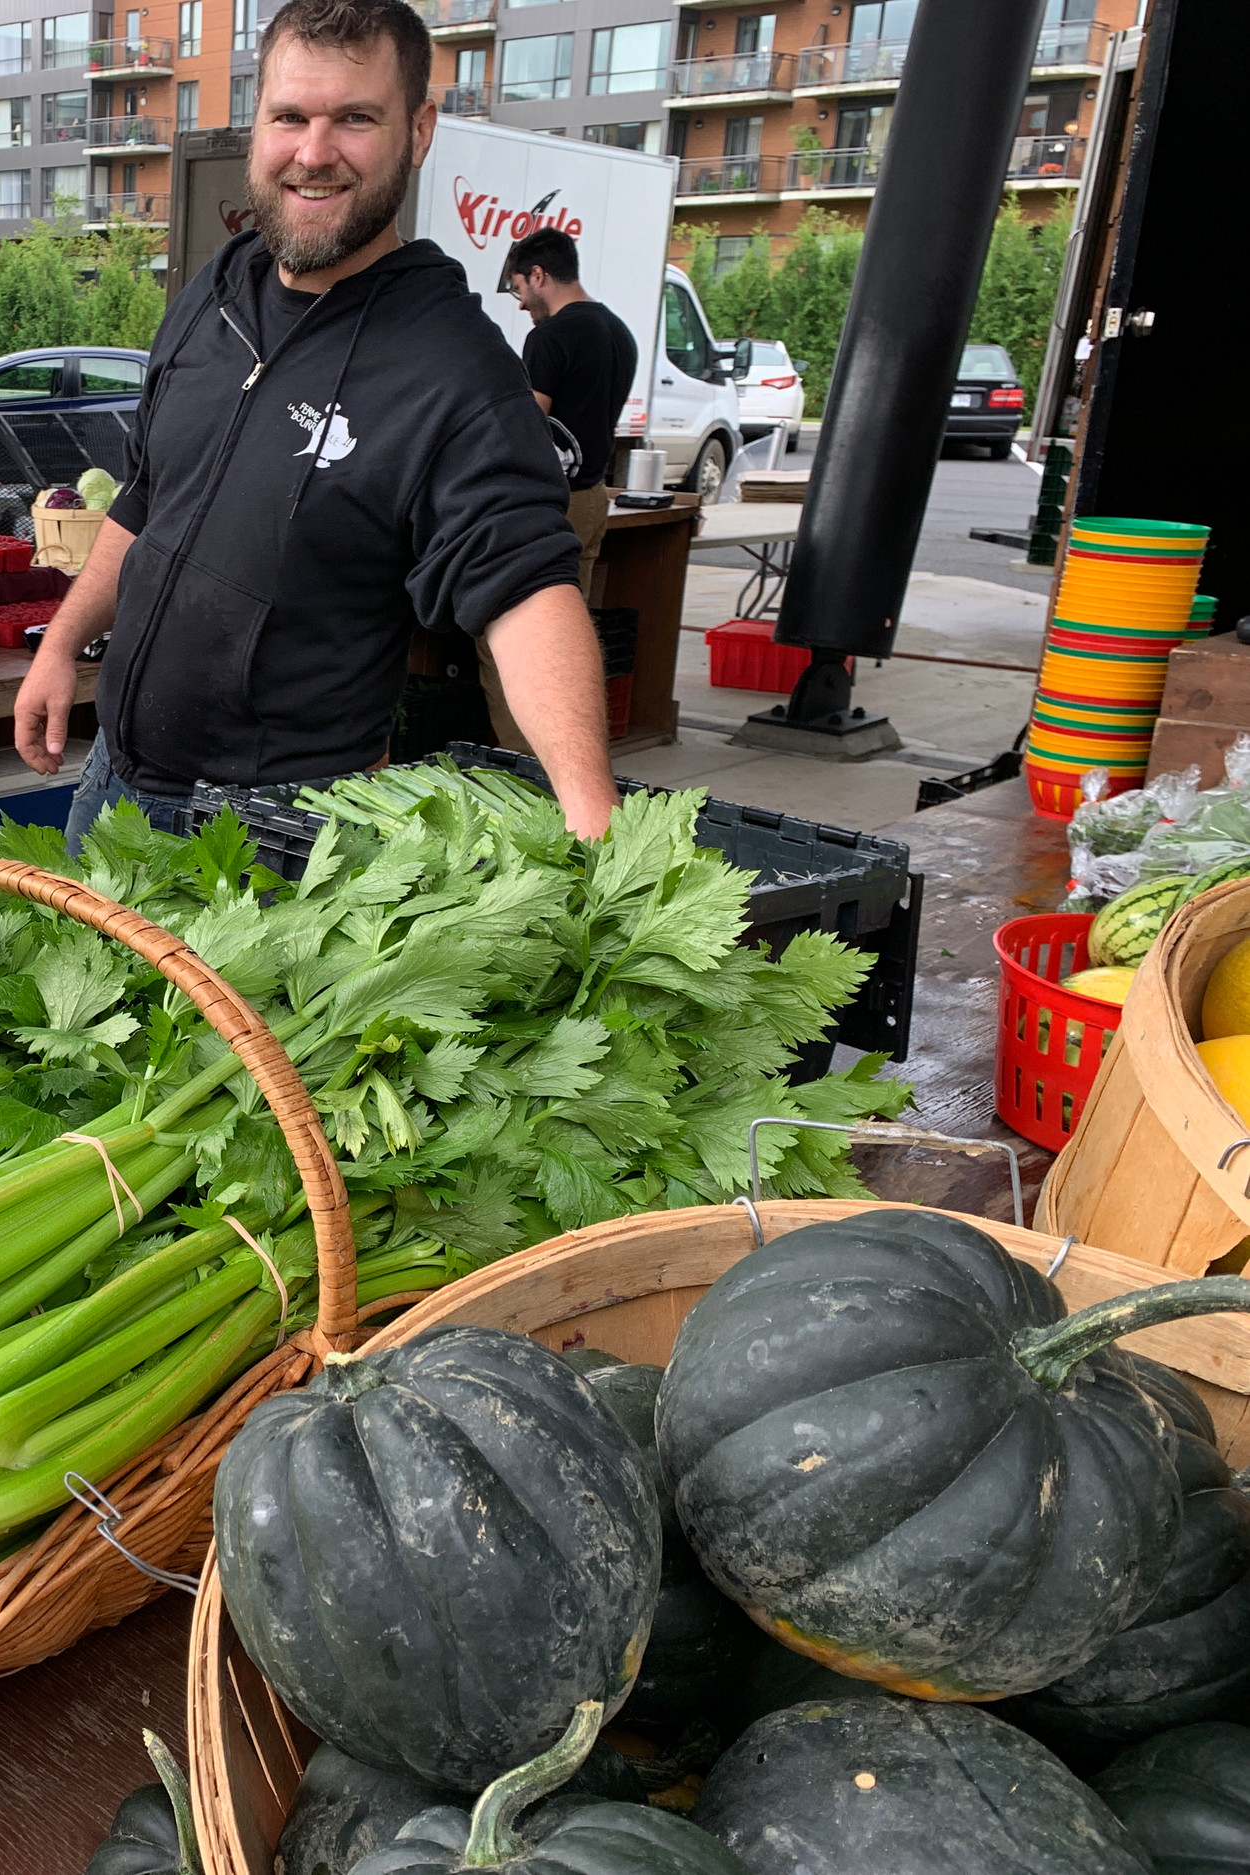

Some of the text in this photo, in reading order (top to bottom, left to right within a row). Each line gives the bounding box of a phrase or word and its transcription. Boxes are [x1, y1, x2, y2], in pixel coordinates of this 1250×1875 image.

[458, 191, 583, 242] Kiroule
[287, 402, 296, 413] LA
[299, 402, 323, 423] FERME
